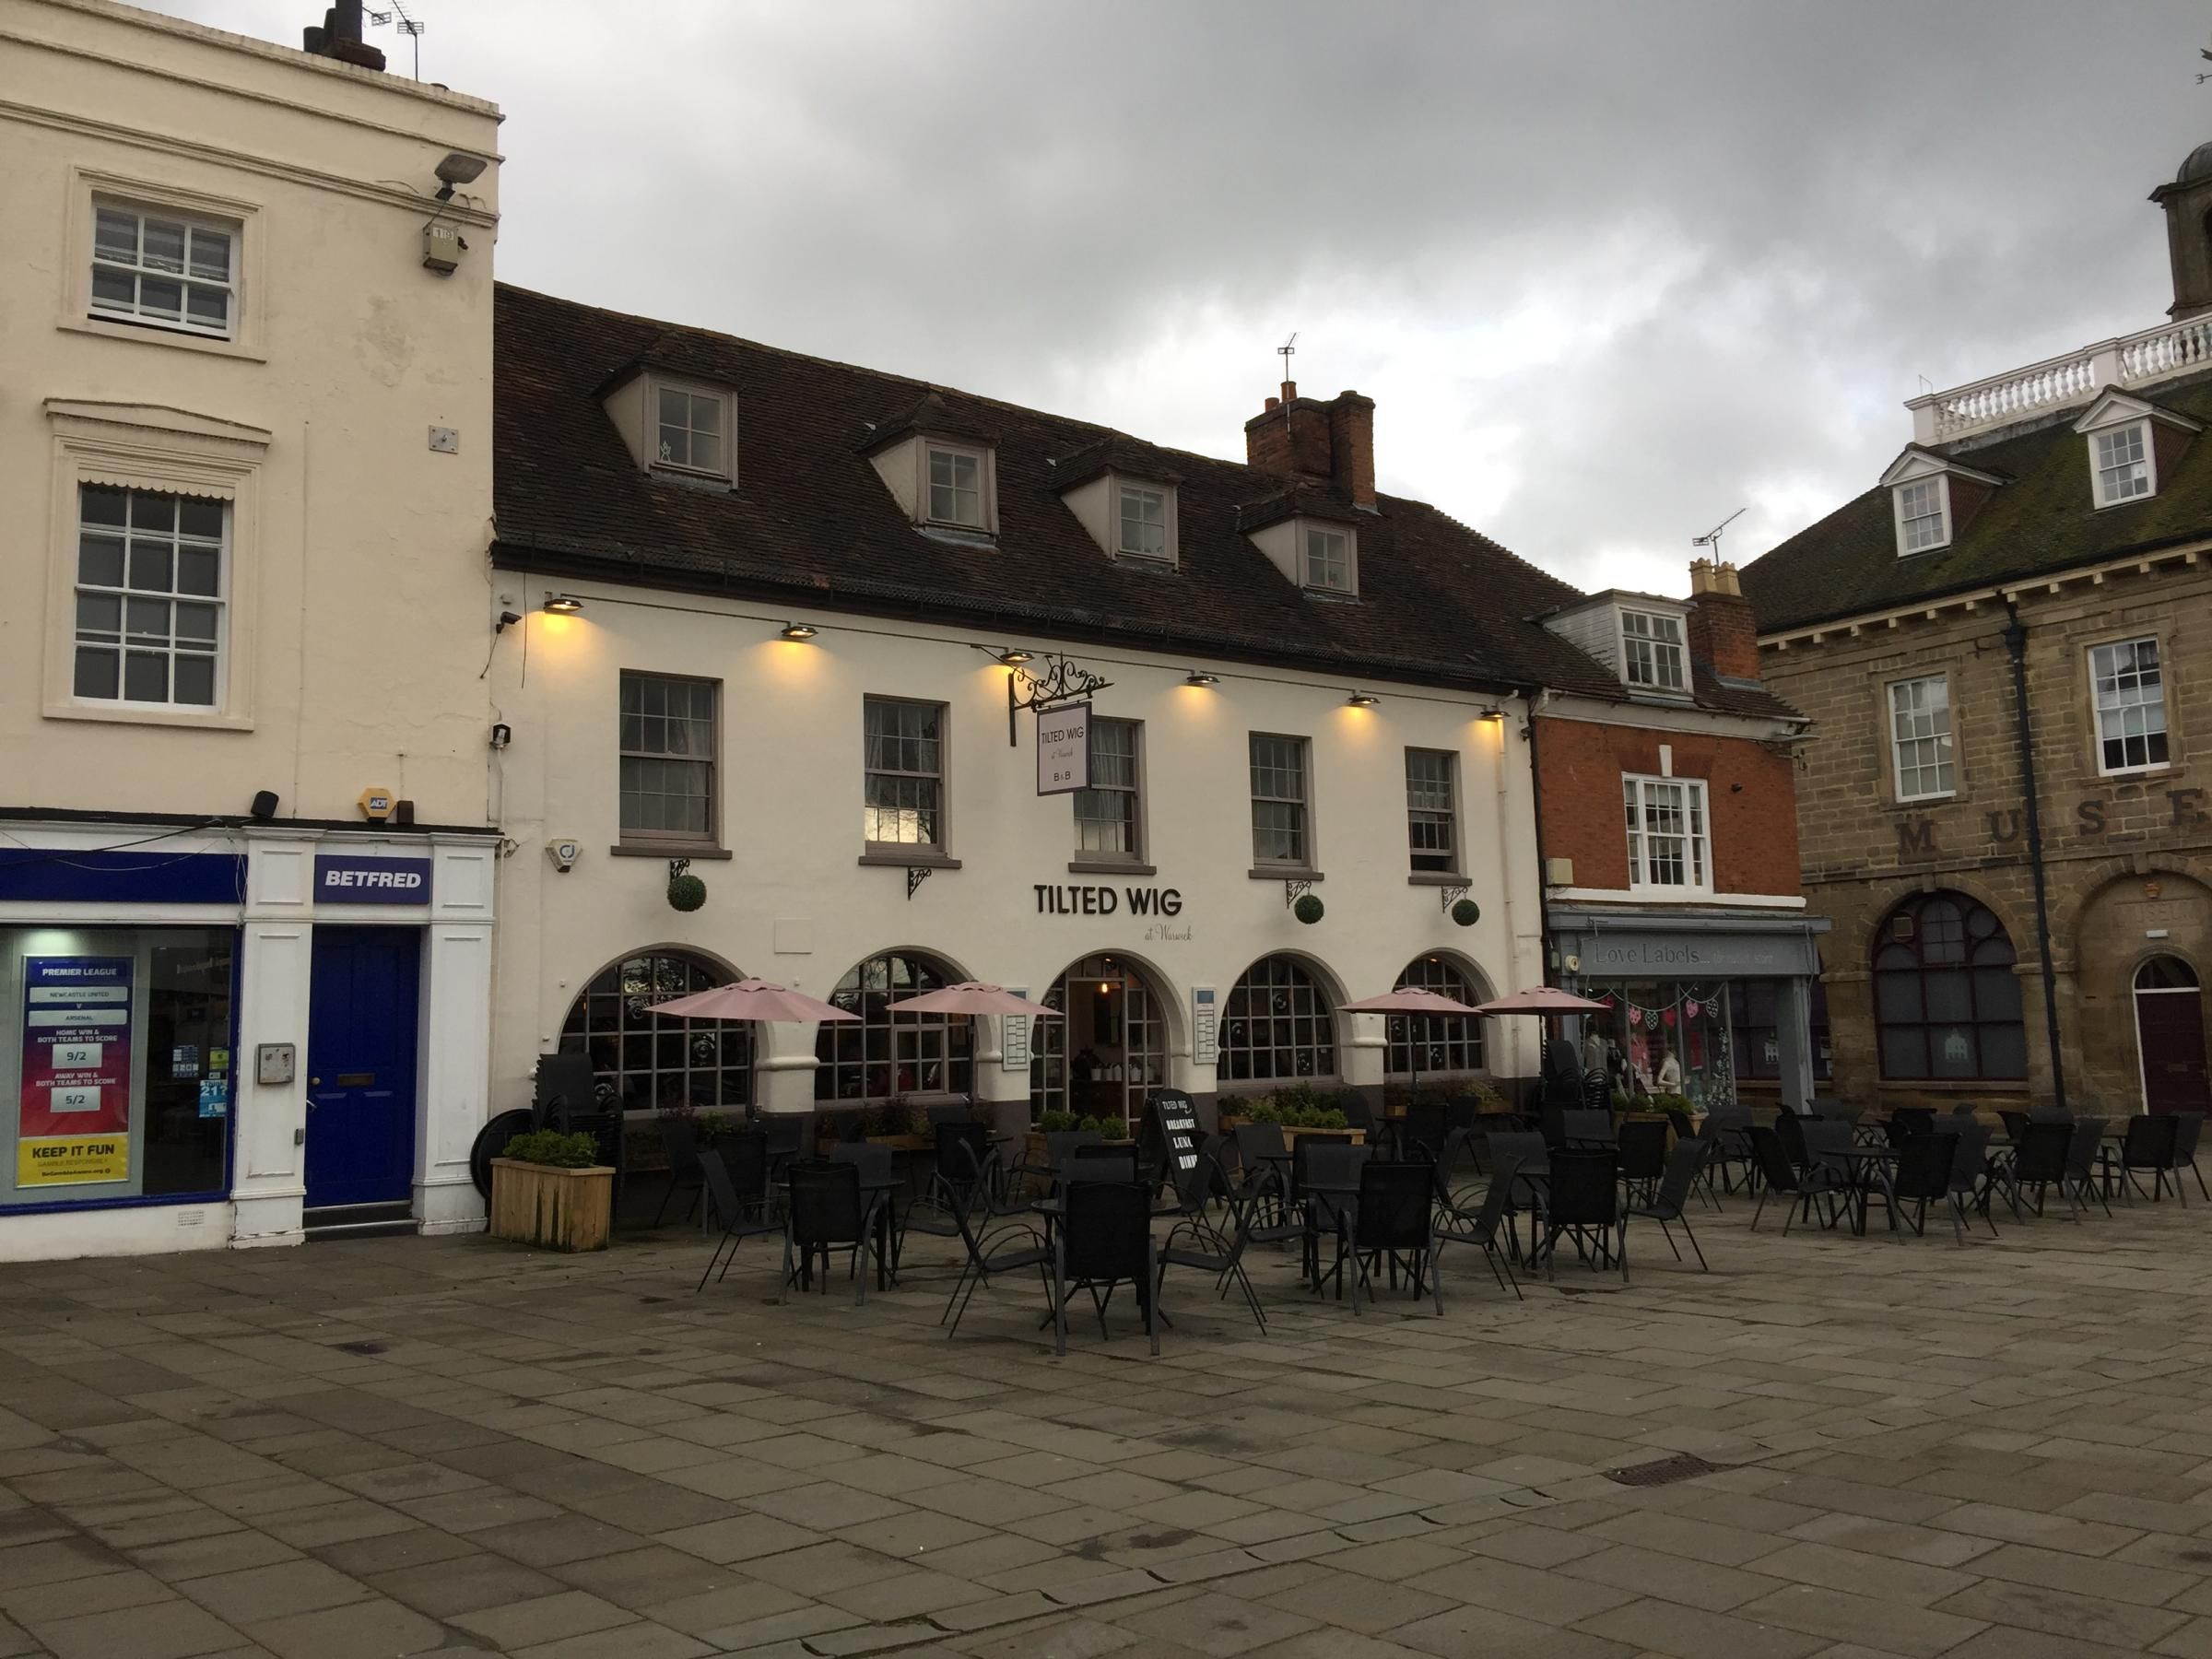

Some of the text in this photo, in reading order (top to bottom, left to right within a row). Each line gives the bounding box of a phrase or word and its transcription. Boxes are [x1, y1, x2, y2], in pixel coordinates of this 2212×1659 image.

[1041, 726, 1084, 745] TILTED WIG
[371, 799, 388, 807] ADT
[324, 870, 422, 888] BETFRED
[1033, 884, 1182, 917] TILTED WIG
[1144, 923, 1193, 942] at Warwick
[1594, 943, 1637, 964] Love
[42, 968, 117, 976] PREMIER LEAGUE
[66, 1051, 87, 1061] 9/2
[200, 1086, 228, 1096] 21?
[65, 1094, 86, 1105] 5/2
[1166, 1119, 1194, 1130] BREAKFAST
[32, 1144, 114, 1159] KEEP IT FUN
